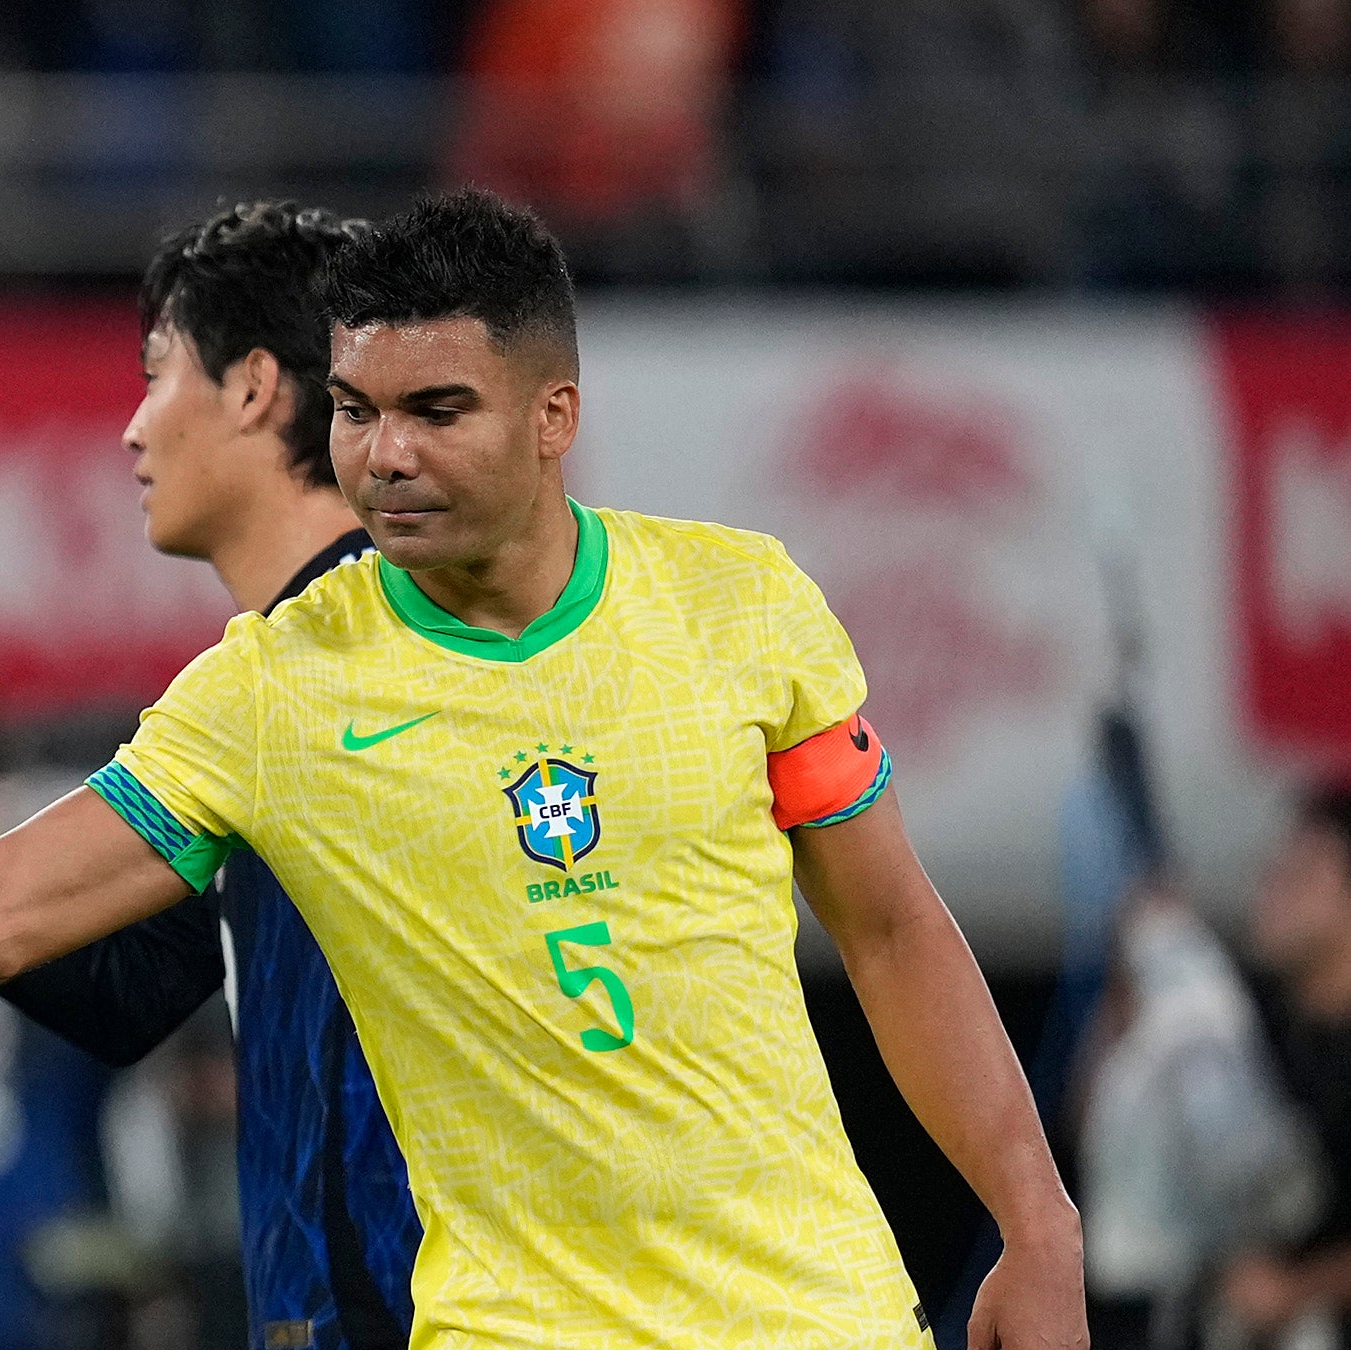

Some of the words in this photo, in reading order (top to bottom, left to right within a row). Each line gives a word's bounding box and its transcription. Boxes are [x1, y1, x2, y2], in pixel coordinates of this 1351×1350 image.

[539, 802, 572, 820] CBF
[525, 870, 620, 904] BRASIL
[544, 920, 635, 1053] 5
